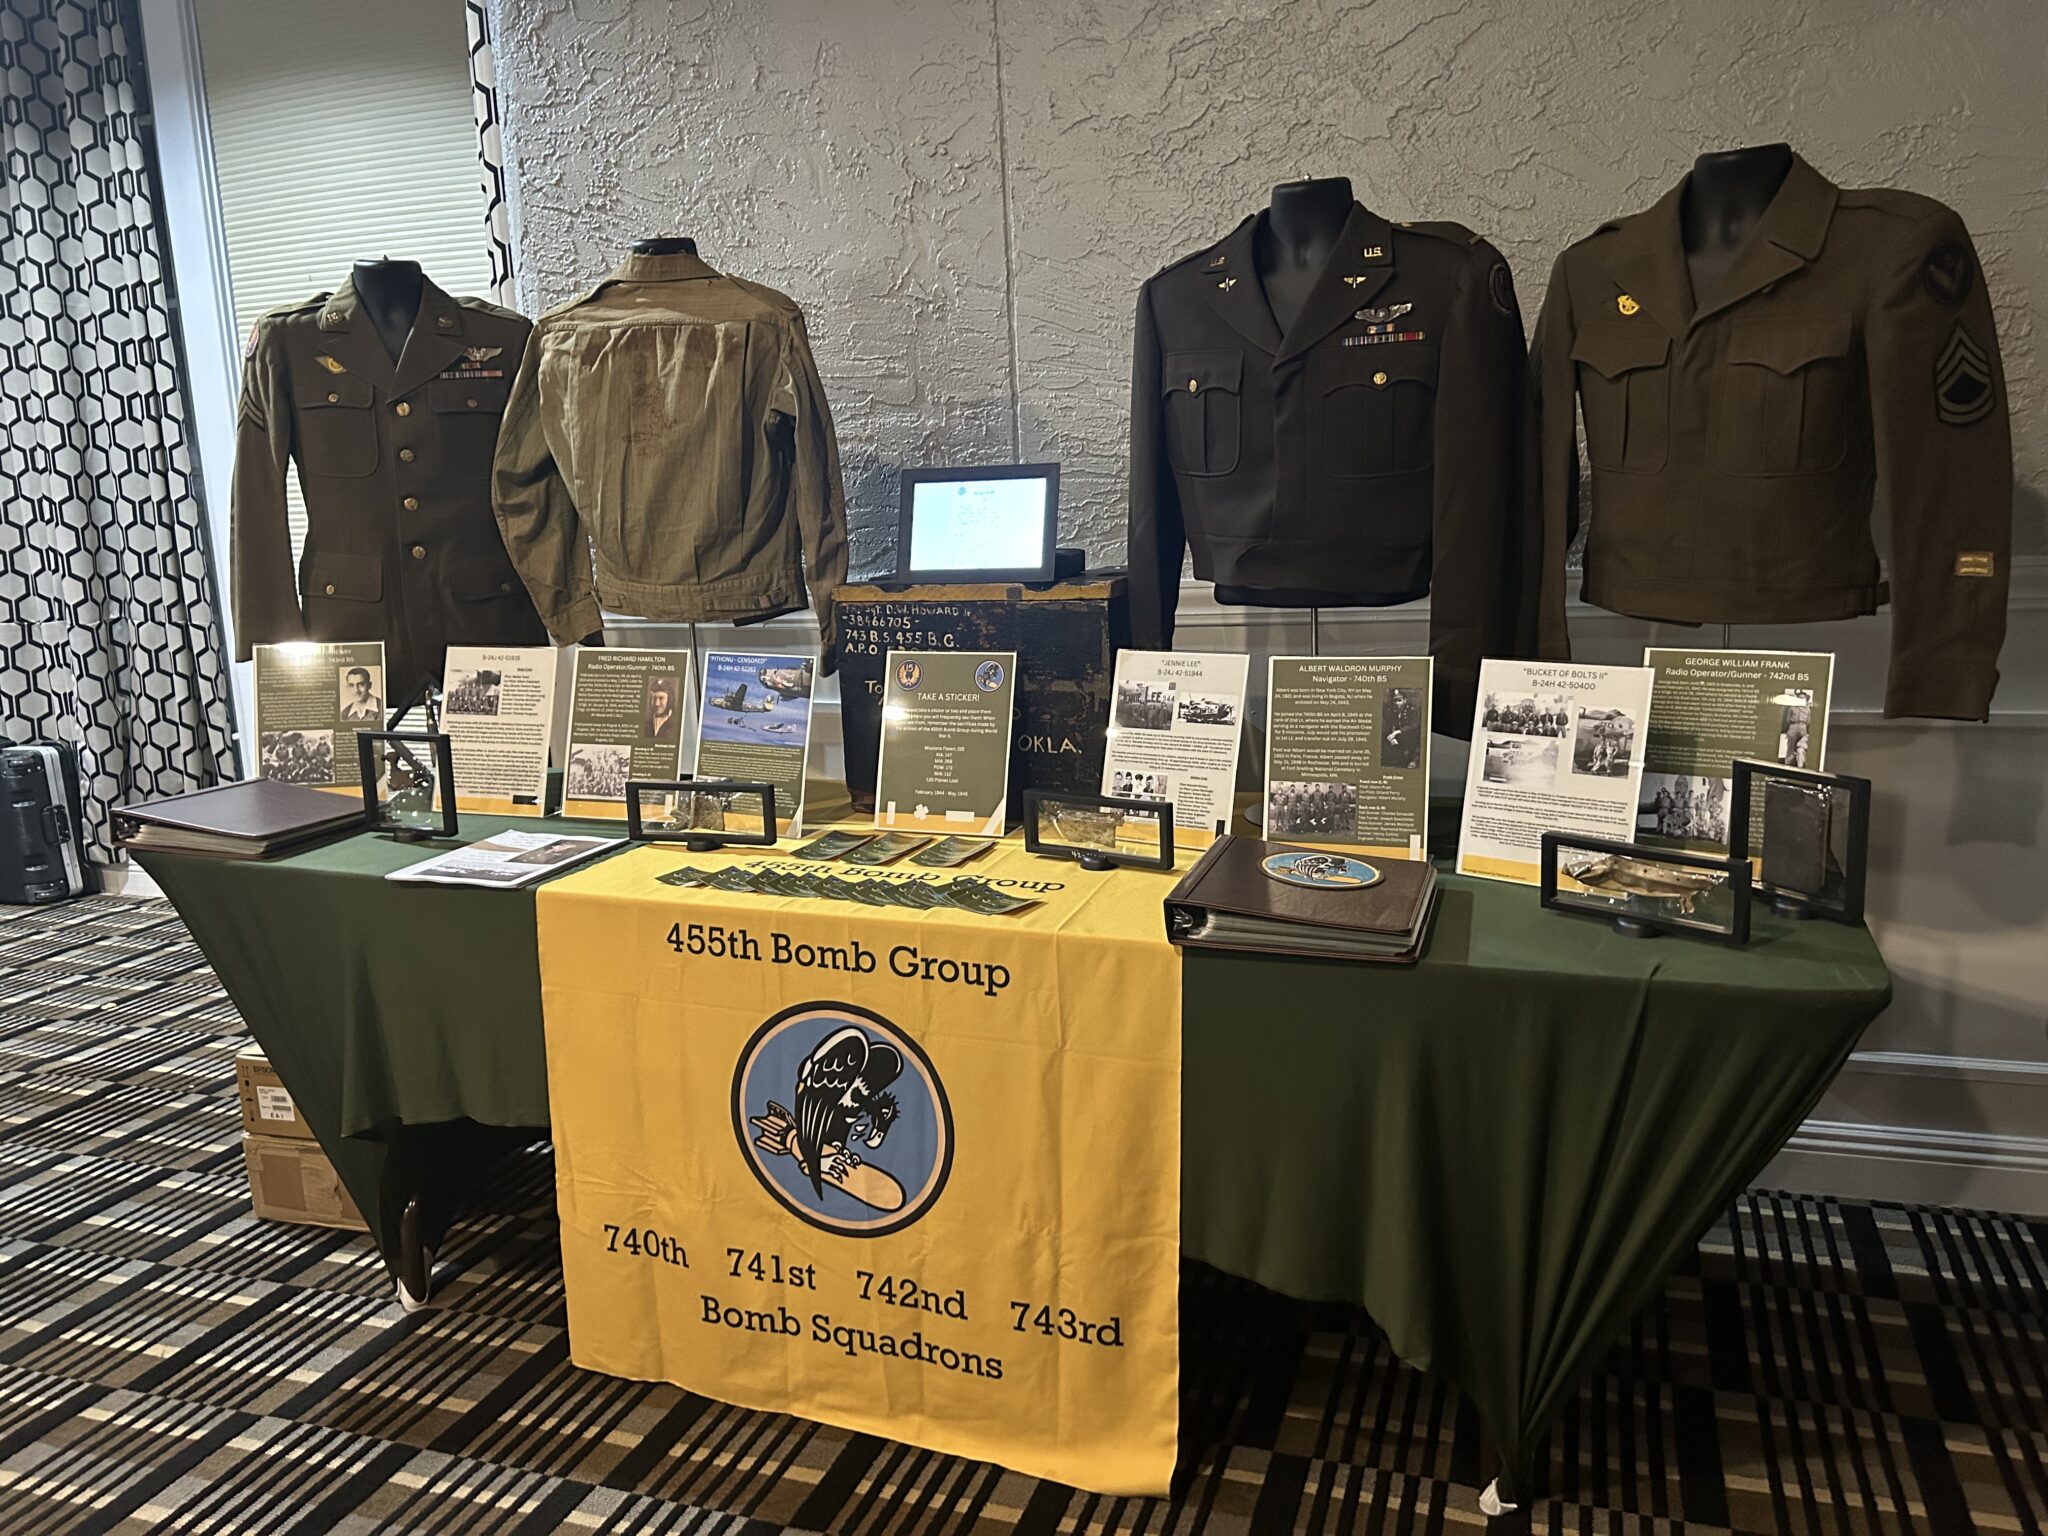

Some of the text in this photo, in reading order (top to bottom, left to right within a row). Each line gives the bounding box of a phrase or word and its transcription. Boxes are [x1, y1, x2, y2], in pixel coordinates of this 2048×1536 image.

[845, 629, 866, 641] 743
[896, 631, 923, 644] 455
[603, 664, 647, 672] Operator/Gunner
[1685, 659, 1790, 669] GEORGE WILLIAM FRANK
[1312, 675, 1347, 684] Navigator
[1523, 668, 1557, 677] "BUCKET
[1558, 670, 1570, 678] OF
[1571, 671, 1597, 679] BOLTS
[1665, 668, 1689, 676] Radio
[1690, 669, 1761, 681] Operator/Gunner
[1768, 672, 1795, 680] 742nd
[1796, 673, 1810, 681] BS
[864, 680, 884, 694] To
[1532, 679, 1596, 690] B-24H 42-50400
[917, 693, 980, 701] TAKE A STICKER!
[1018, 734, 1083, 754] OKLA.
[745, 860, 832, 874] 455th
[838, 867, 941, 881] Bomb
[666, 922, 1011, 997] 455th Bomb Group
[254, 1066, 275, 1074] EPSO
[603, 1224, 1124, 1347] 740th 741st 742nd 743rd
[701, 1295, 1003, 1380] Bomb Squadrons
